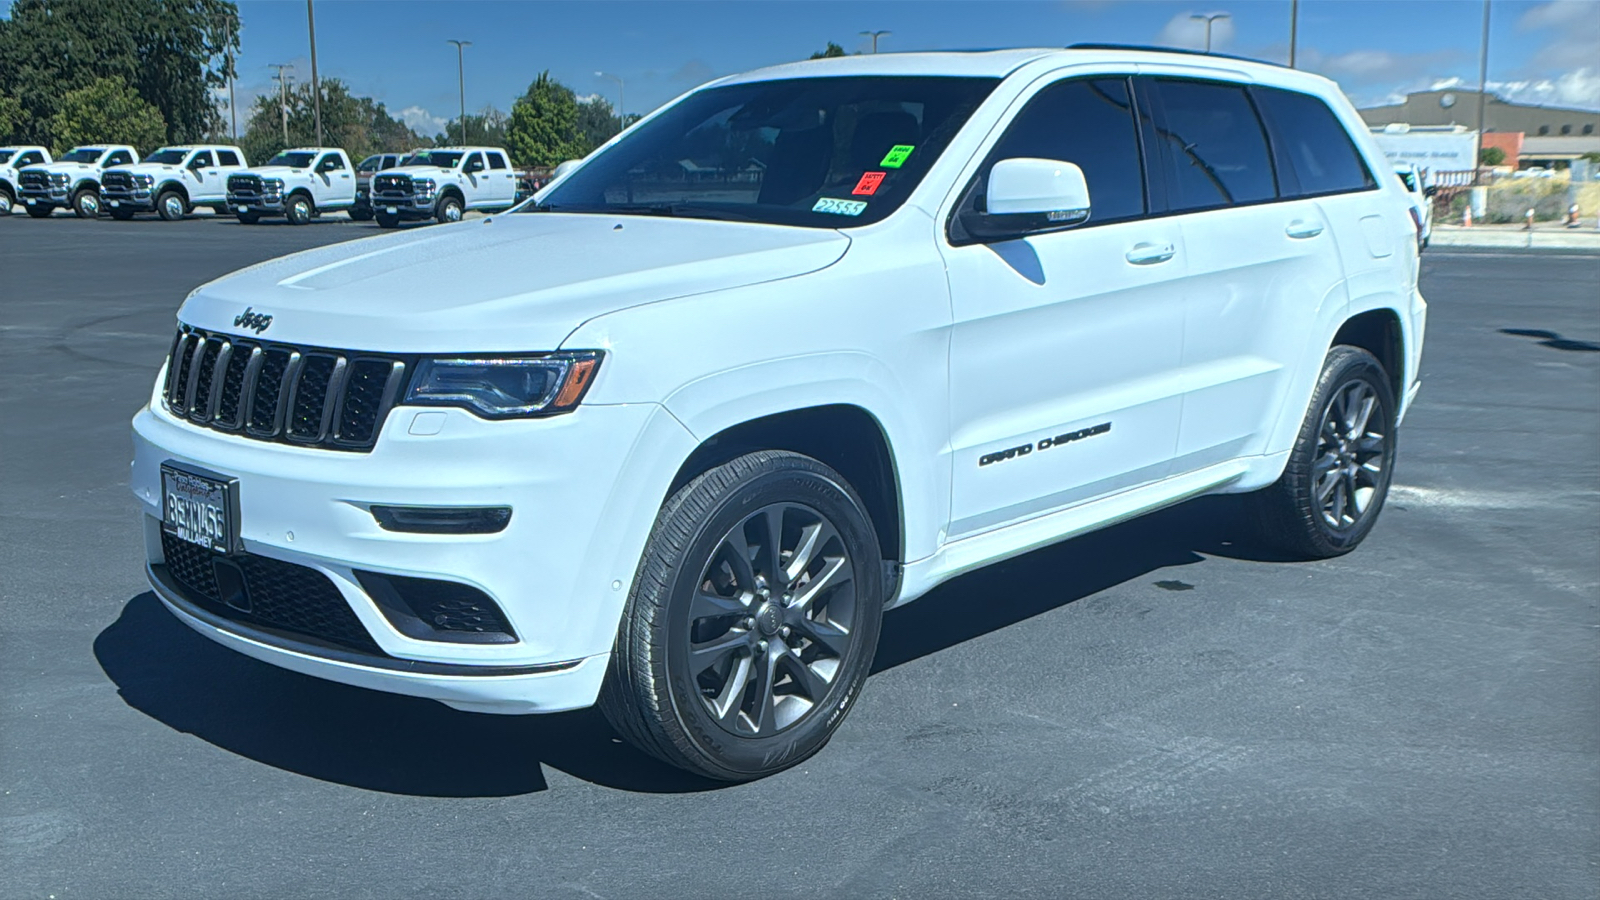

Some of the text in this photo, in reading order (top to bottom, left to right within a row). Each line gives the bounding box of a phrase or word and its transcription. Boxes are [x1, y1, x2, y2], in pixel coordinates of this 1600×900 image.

[816, 199, 864, 213] 22555
[233, 306, 273, 335] Jeep
[979, 421, 1113, 466] GRAND CHEROKEE
